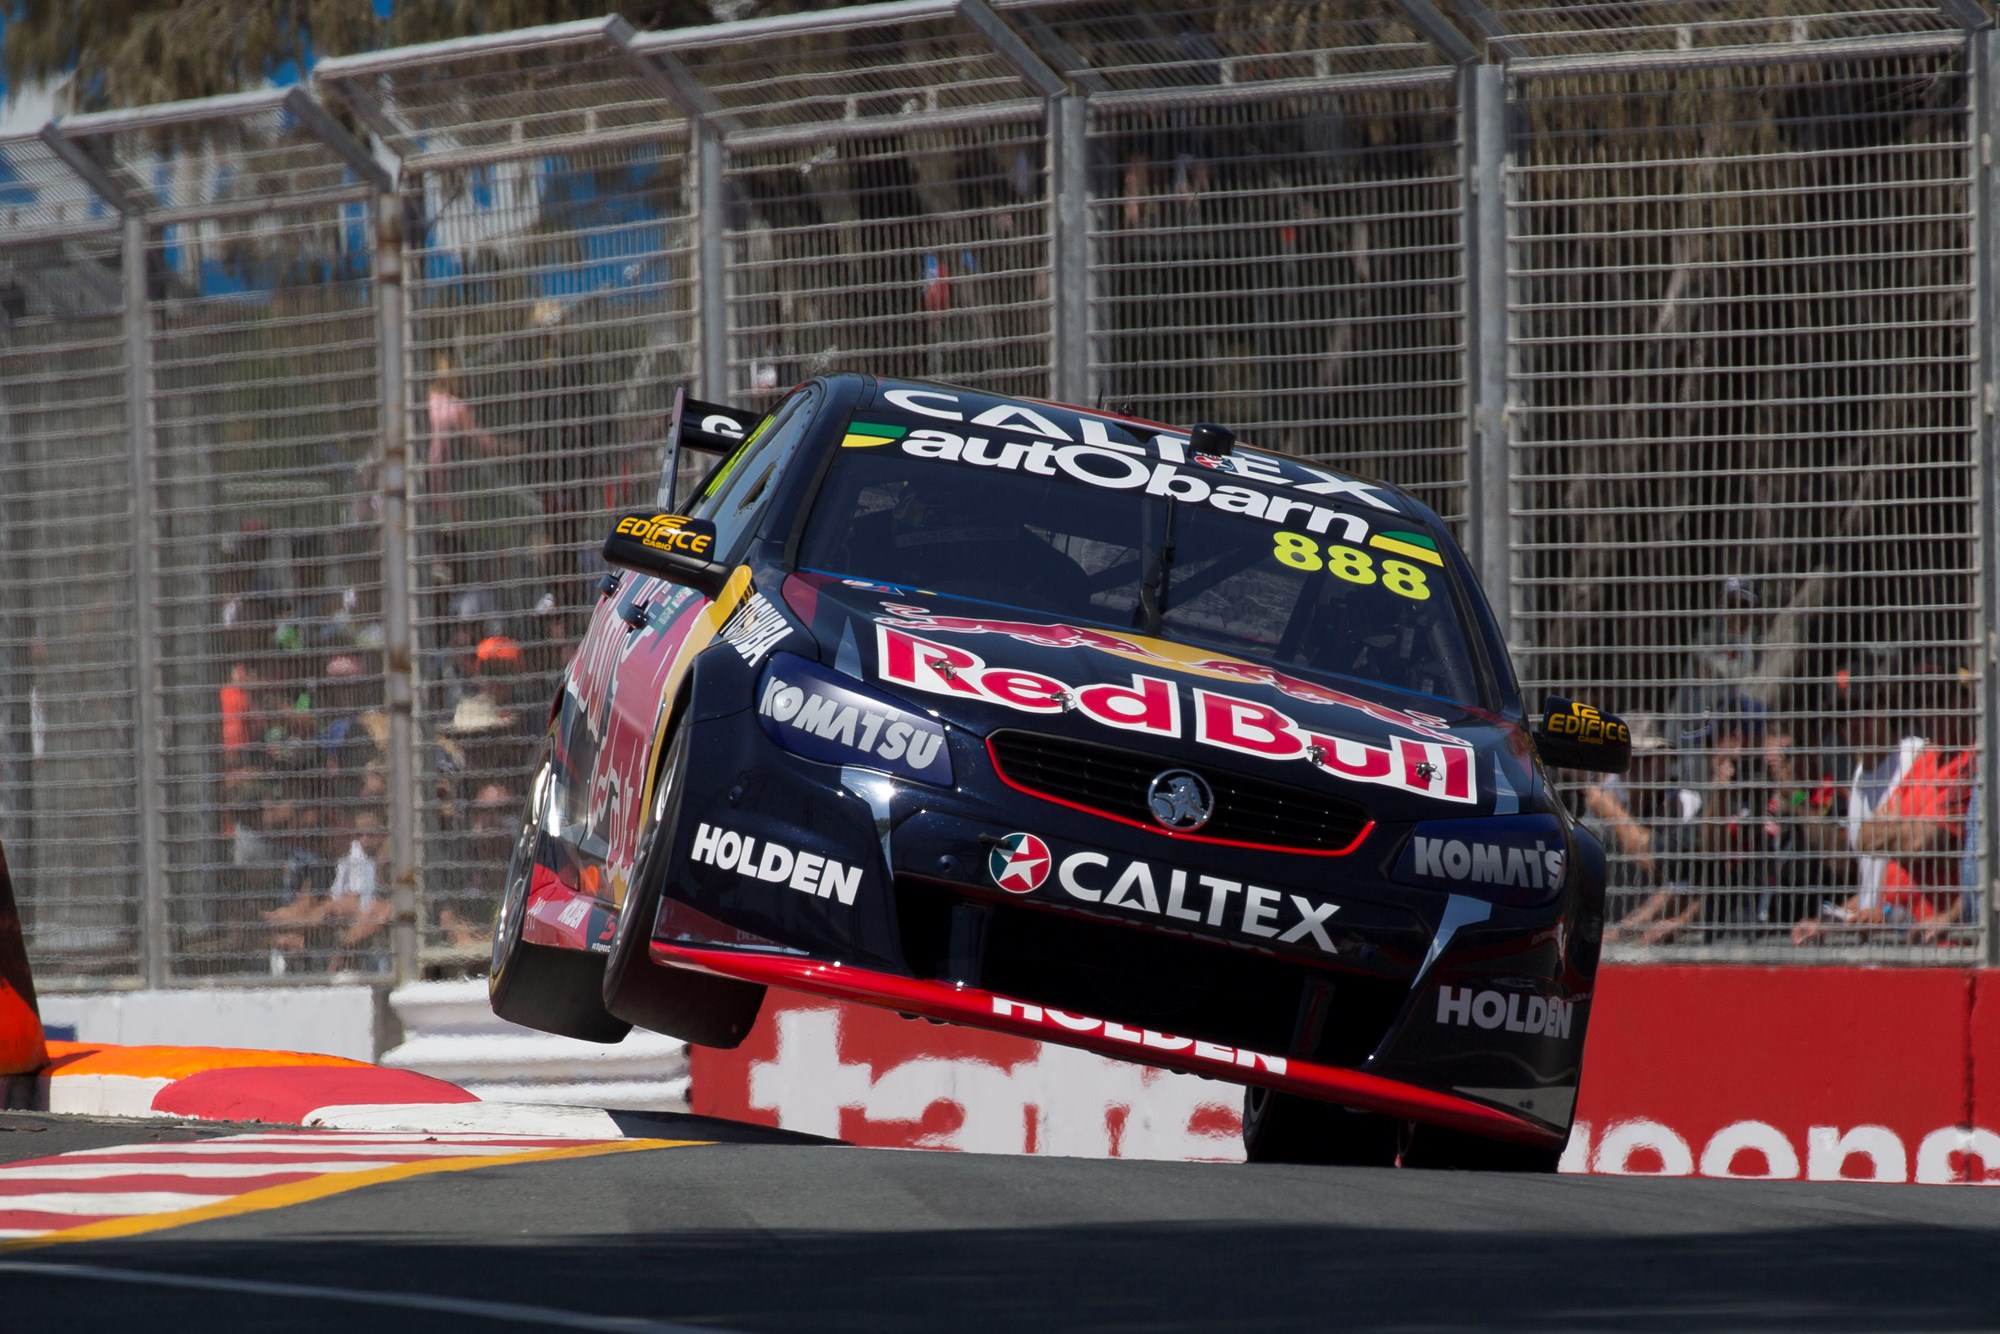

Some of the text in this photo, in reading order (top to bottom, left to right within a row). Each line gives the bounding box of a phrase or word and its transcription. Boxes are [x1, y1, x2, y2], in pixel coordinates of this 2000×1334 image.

[884, 389, 1399, 513] CALTEX
[616, 517, 712, 553] EDIFICE
[642, 539, 672, 551] CASIO
[1273, 531, 1431, 600] 888
[720, 592, 794, 667] TOSHIBA
[759, 676, 943, 769] KOMATSU
[876, 623, 1477, 803] Red Bull
[1547, 713, 1628, 742] EDIFICE
[691, 823, 863, 905] HOLDEN
[1414, 837, 1566, 889] KOMATS
[1058, 852, 1341, 953] CALTEX
[1436, 986, 1573, 1039] HOLDEN
